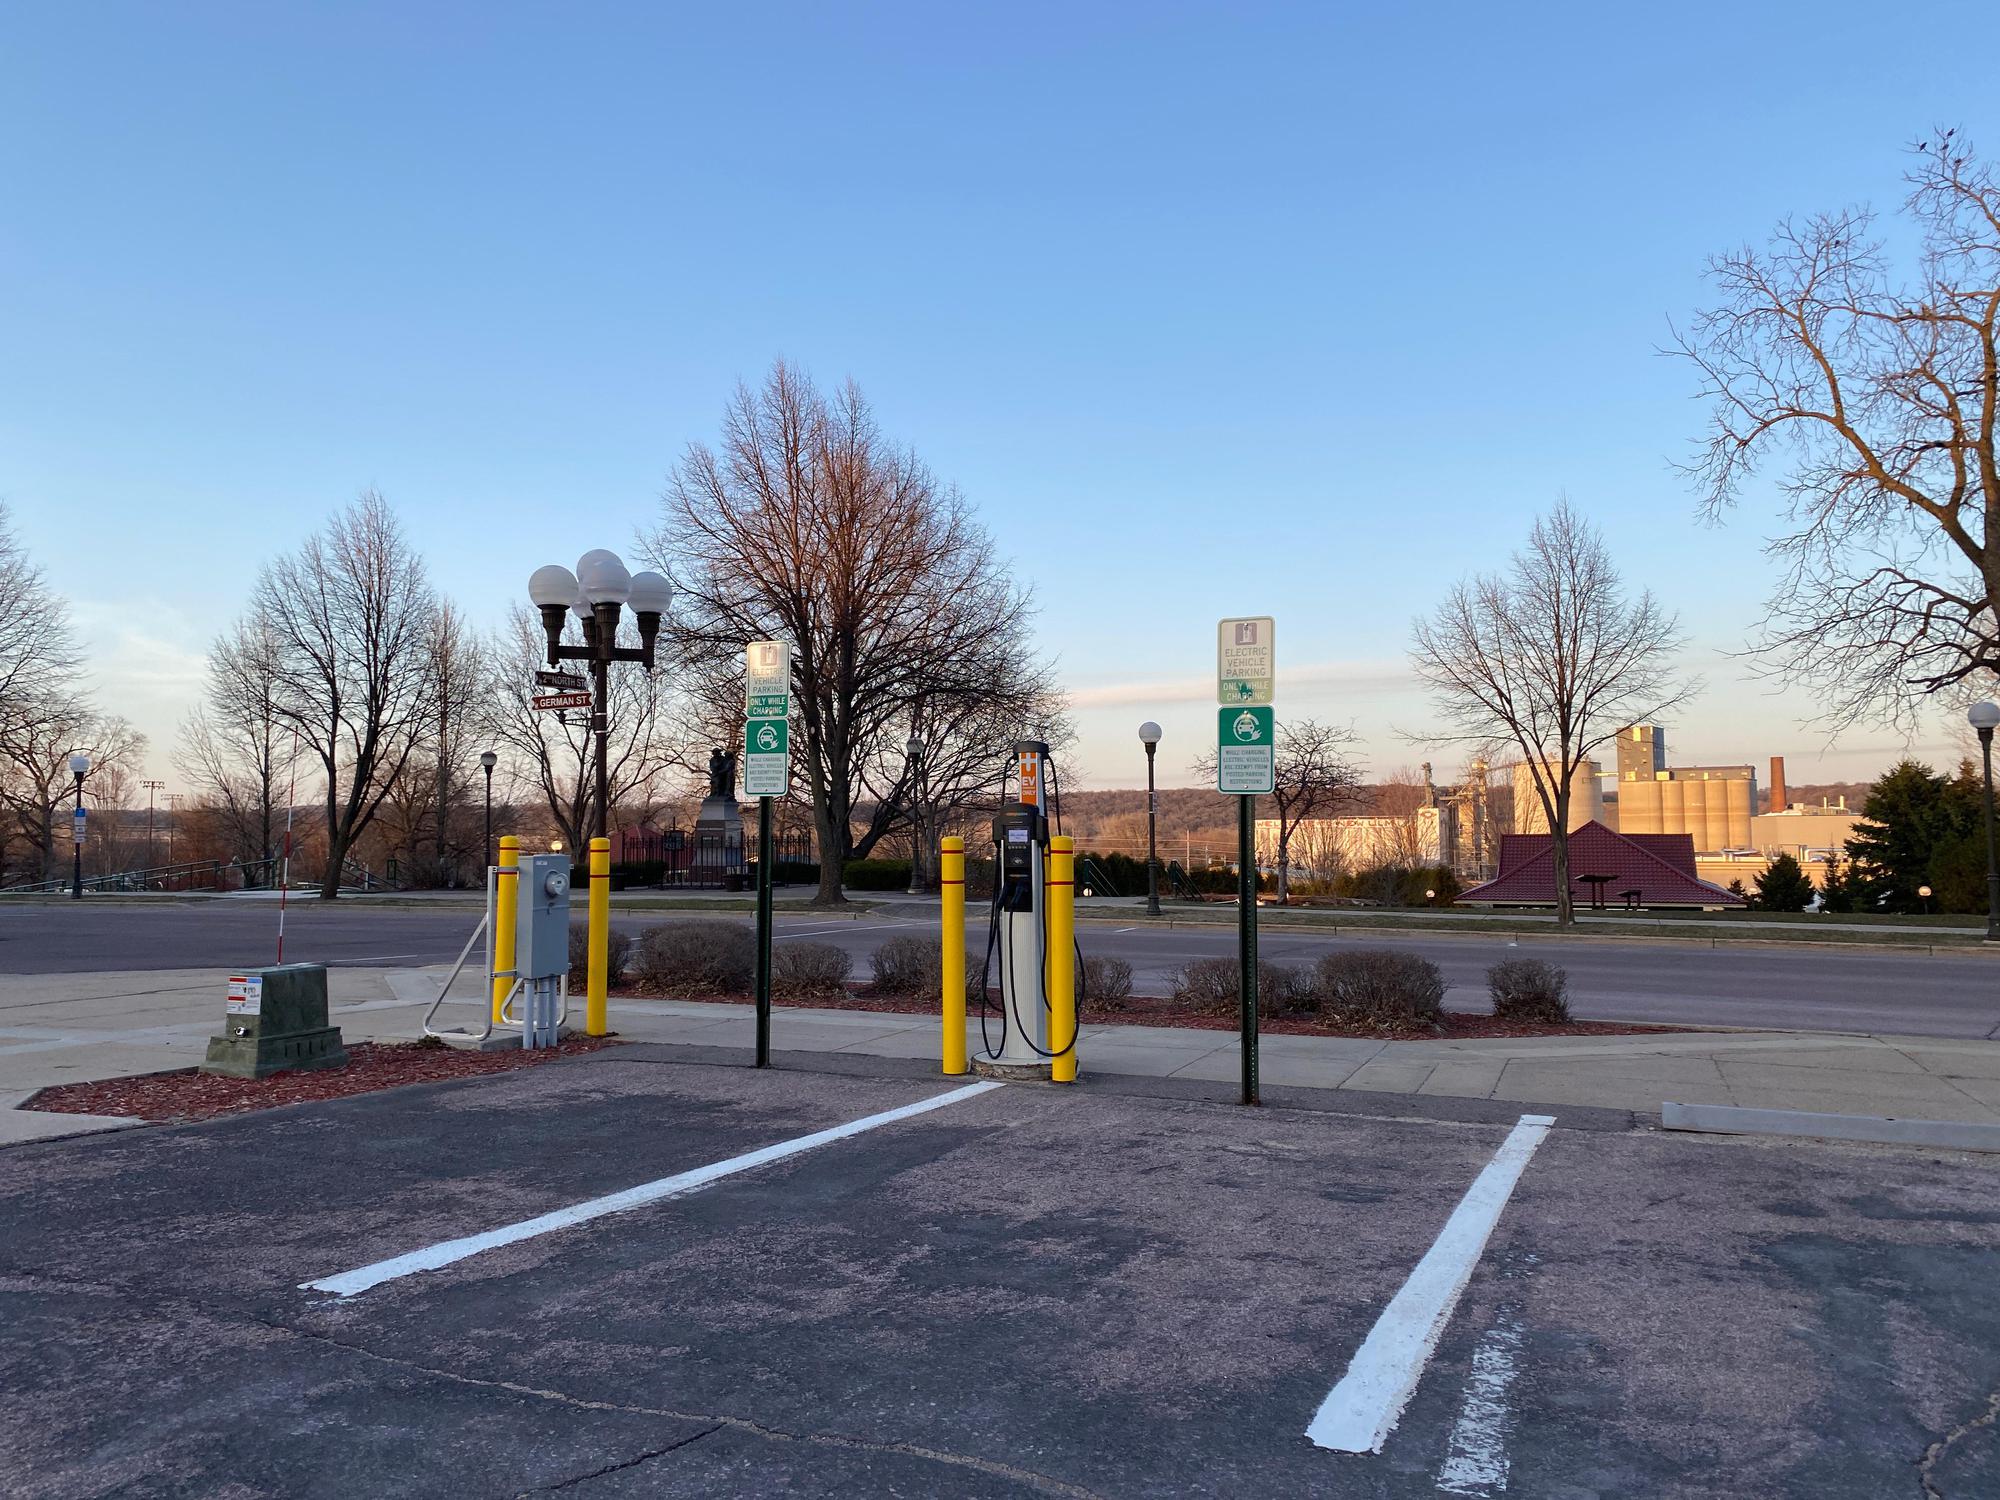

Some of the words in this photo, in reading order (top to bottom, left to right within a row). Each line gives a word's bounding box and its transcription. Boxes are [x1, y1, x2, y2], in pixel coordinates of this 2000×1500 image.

[1225, 647, 1267, 657] ELECTRIC
[1227, 657, 1265, 667] VEHICLE
[752, 668, 784, 676] ELECTRIC
[1226, 668, 1266, 677] PARKING
[552, 676, 576, 687] NORTH
[577, 679, 585, 688] ST
[754, 677, 783, 685] VEHICLE
[753, 686, 783, 694] PARKING
[1223, 682, 1243, 691] ONLY
[1246, 681, 1269, 690] WHILE
[1227, 692, 1265, 701] CHARGING
[540, 697, 574, 707] GERMAN
[576, 696, 587, 705] ST
[751, 697, 766, 706] ONLY
[768, 697, 786, 705] WHILE
[752, 706, 783, 715] CHARGING
[1022, 776, 1036, 786] EV
